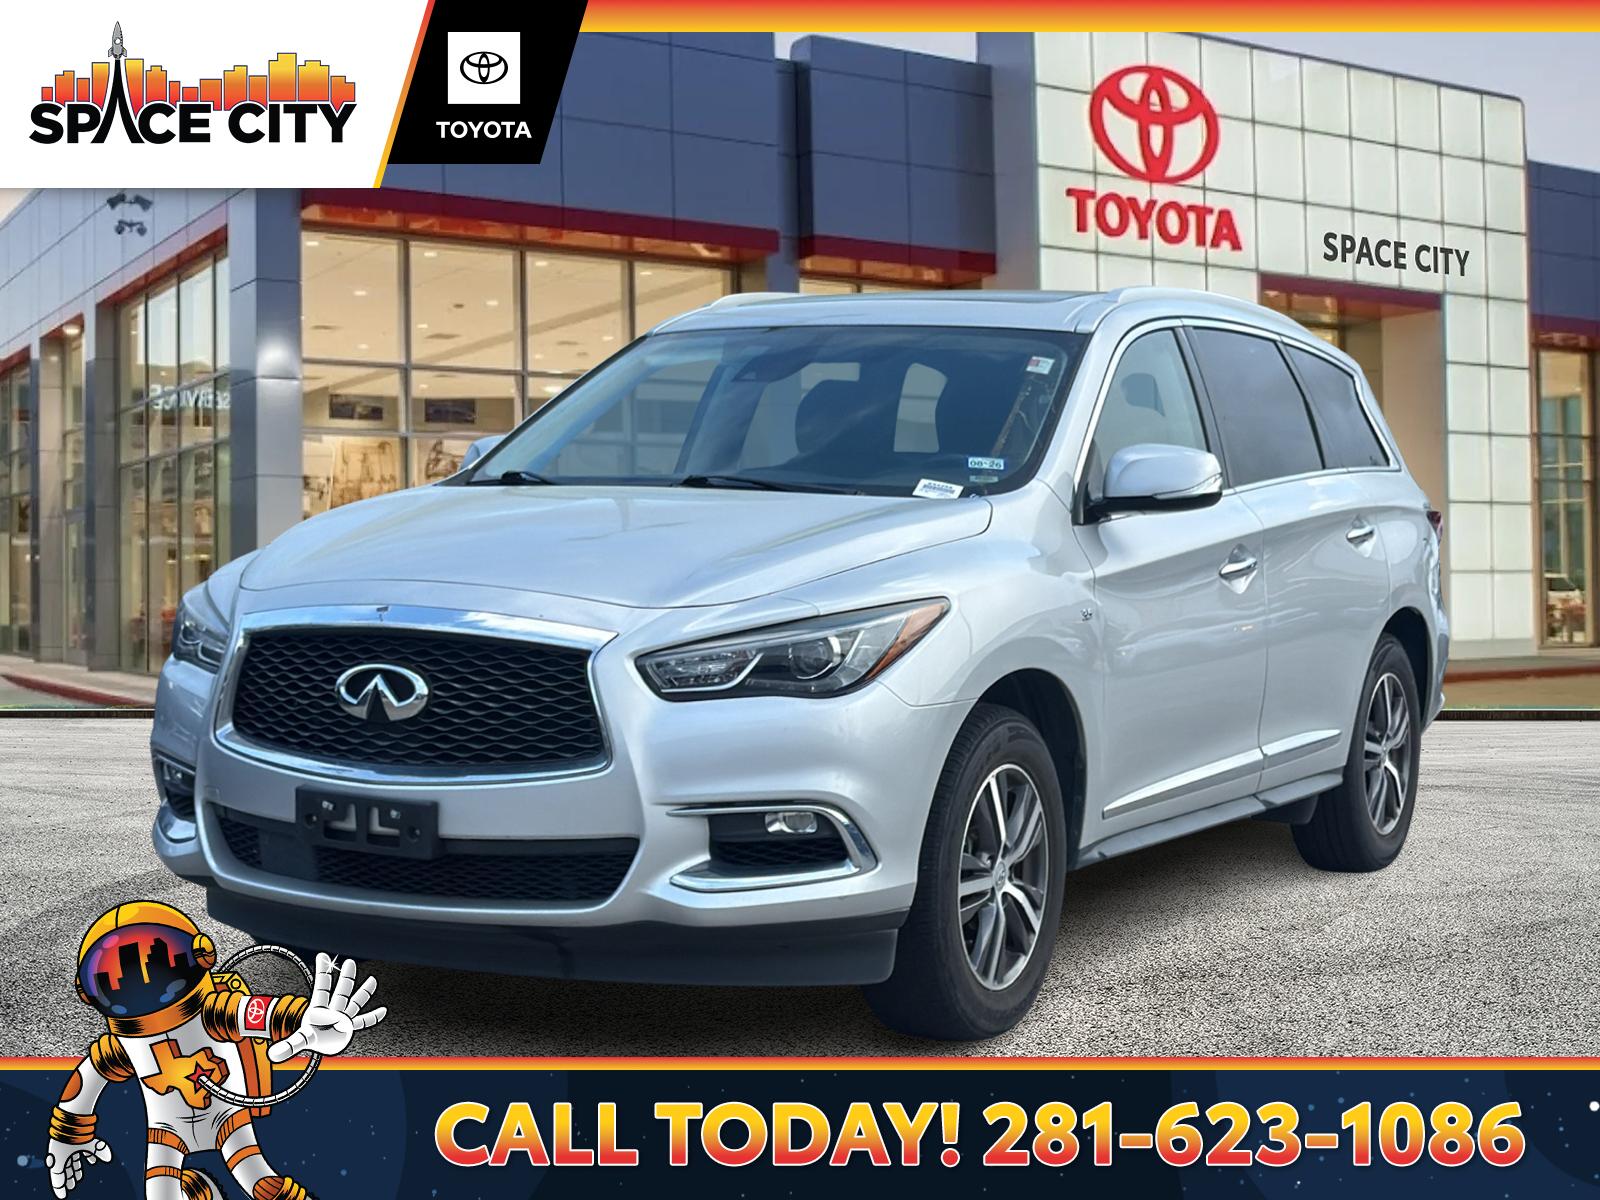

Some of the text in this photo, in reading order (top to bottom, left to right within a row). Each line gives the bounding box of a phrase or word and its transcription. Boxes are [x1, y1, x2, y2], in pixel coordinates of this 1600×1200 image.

[1066, 187, 1242, 251] TOYOTA
[1322, 231, 1470, 277] SPACE CITY
